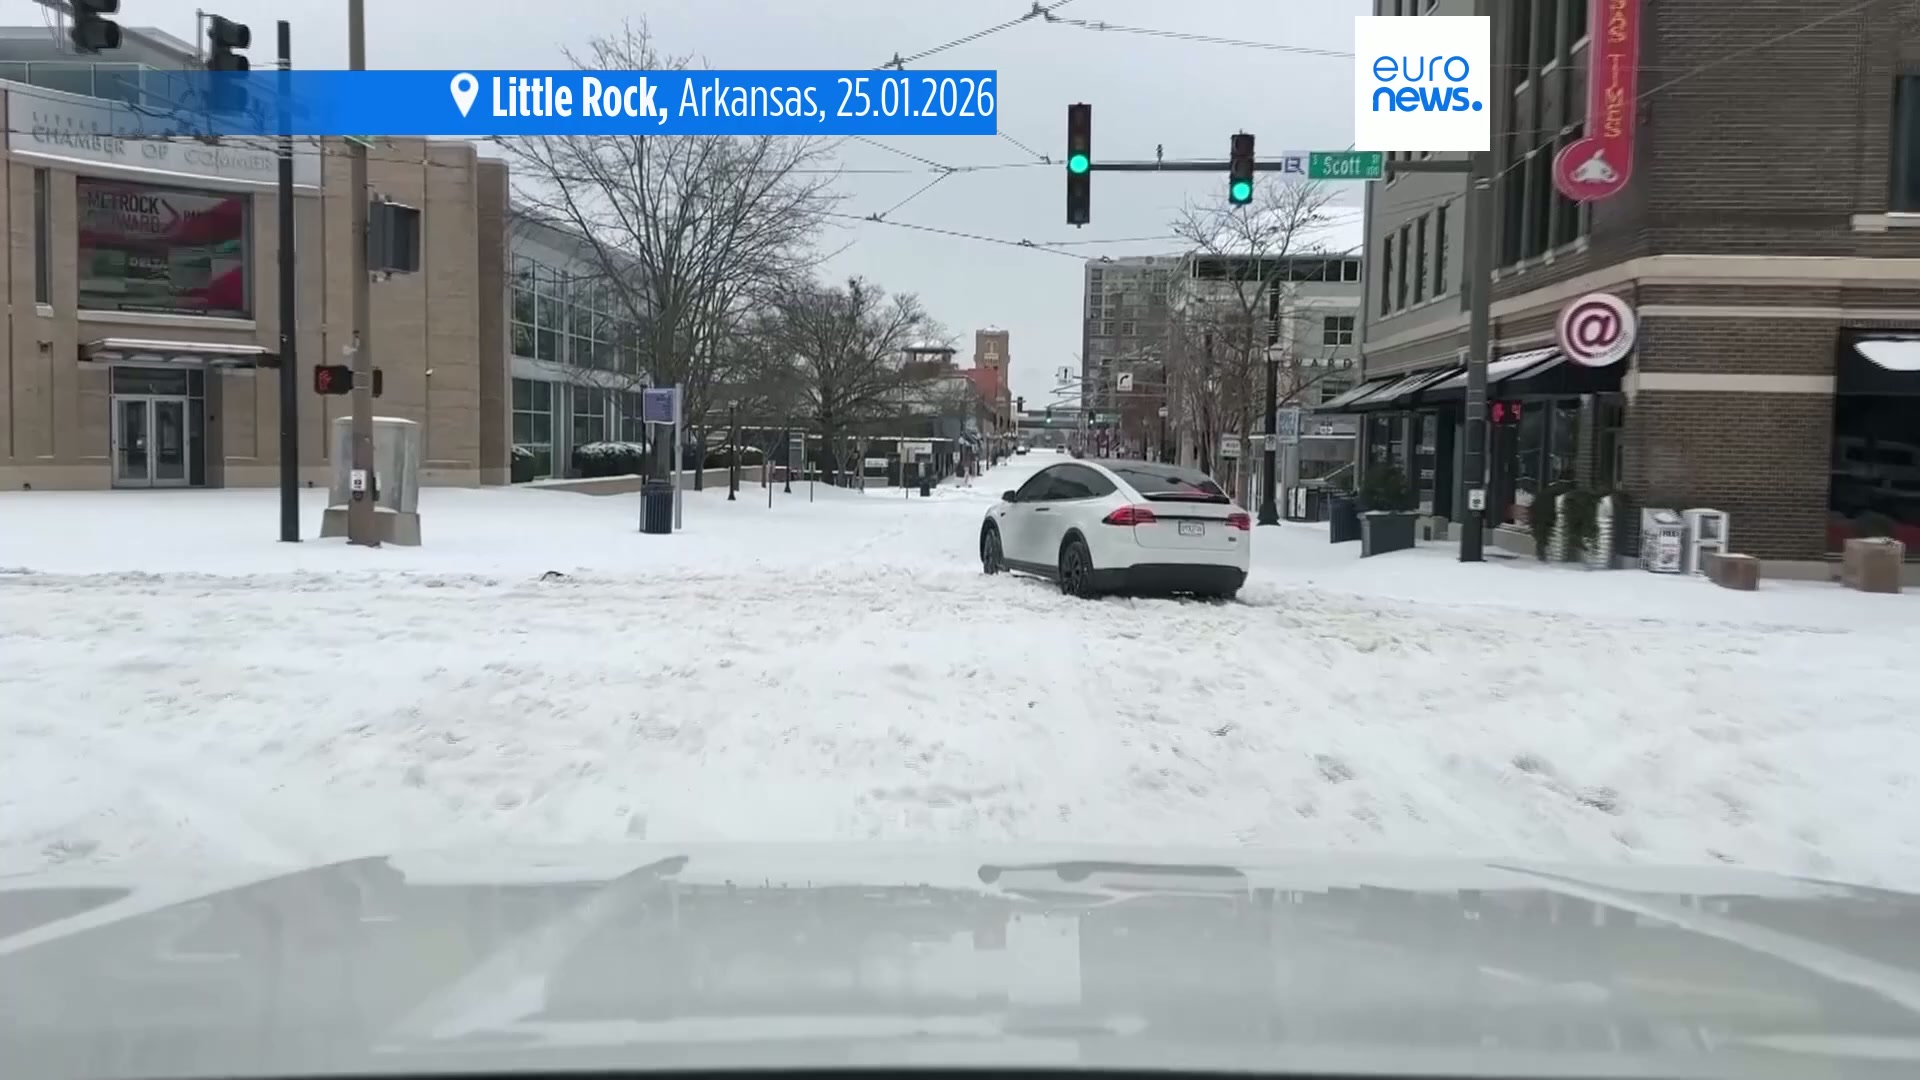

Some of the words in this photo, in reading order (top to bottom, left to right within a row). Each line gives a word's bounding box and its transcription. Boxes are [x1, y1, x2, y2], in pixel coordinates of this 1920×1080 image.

[1603, 53, 1627, 138] TIMES
[32, 124, 125, 154] CHAMBER
[142, 144, 169, 160] OF
[1323, 155, 1361, 176] Scott
